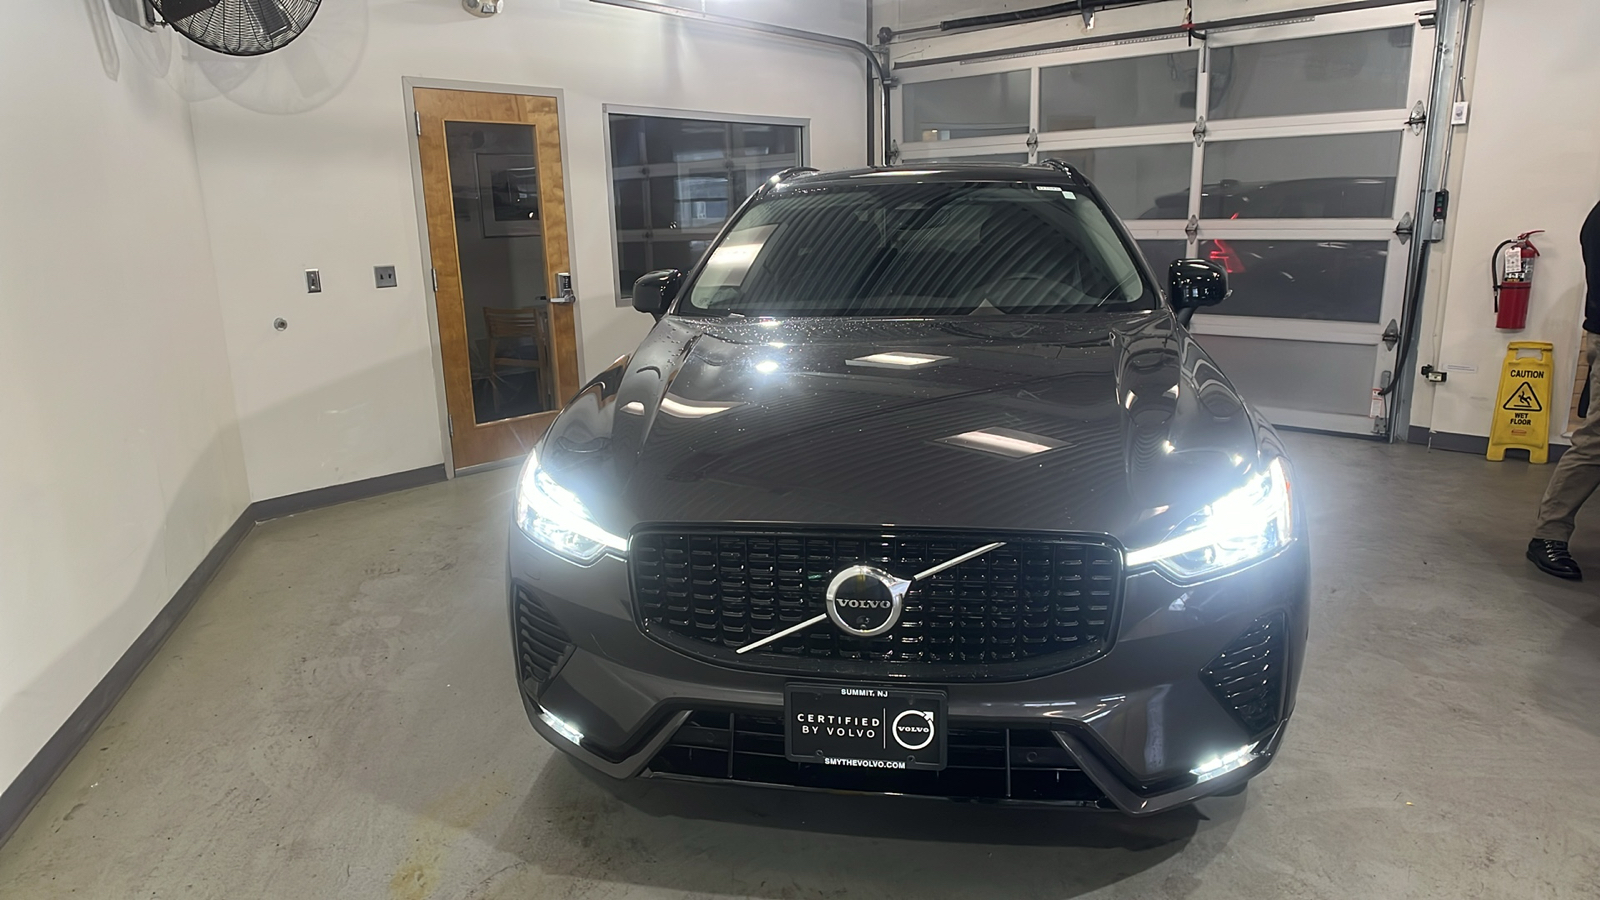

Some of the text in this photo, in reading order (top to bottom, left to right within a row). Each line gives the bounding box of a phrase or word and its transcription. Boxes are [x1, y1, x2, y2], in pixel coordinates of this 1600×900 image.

[1510, 370, 1544, 378] CAUTION
[836, 598, 891, 609] VOLVO
[876, 690, 888, 698] NJ
[797, 713, 880, 727] CERTIFIED
[802, 726, 875, 738] BY VOLVO
[824, 757, 906, 769] SMYTHEVOLVO.COM
